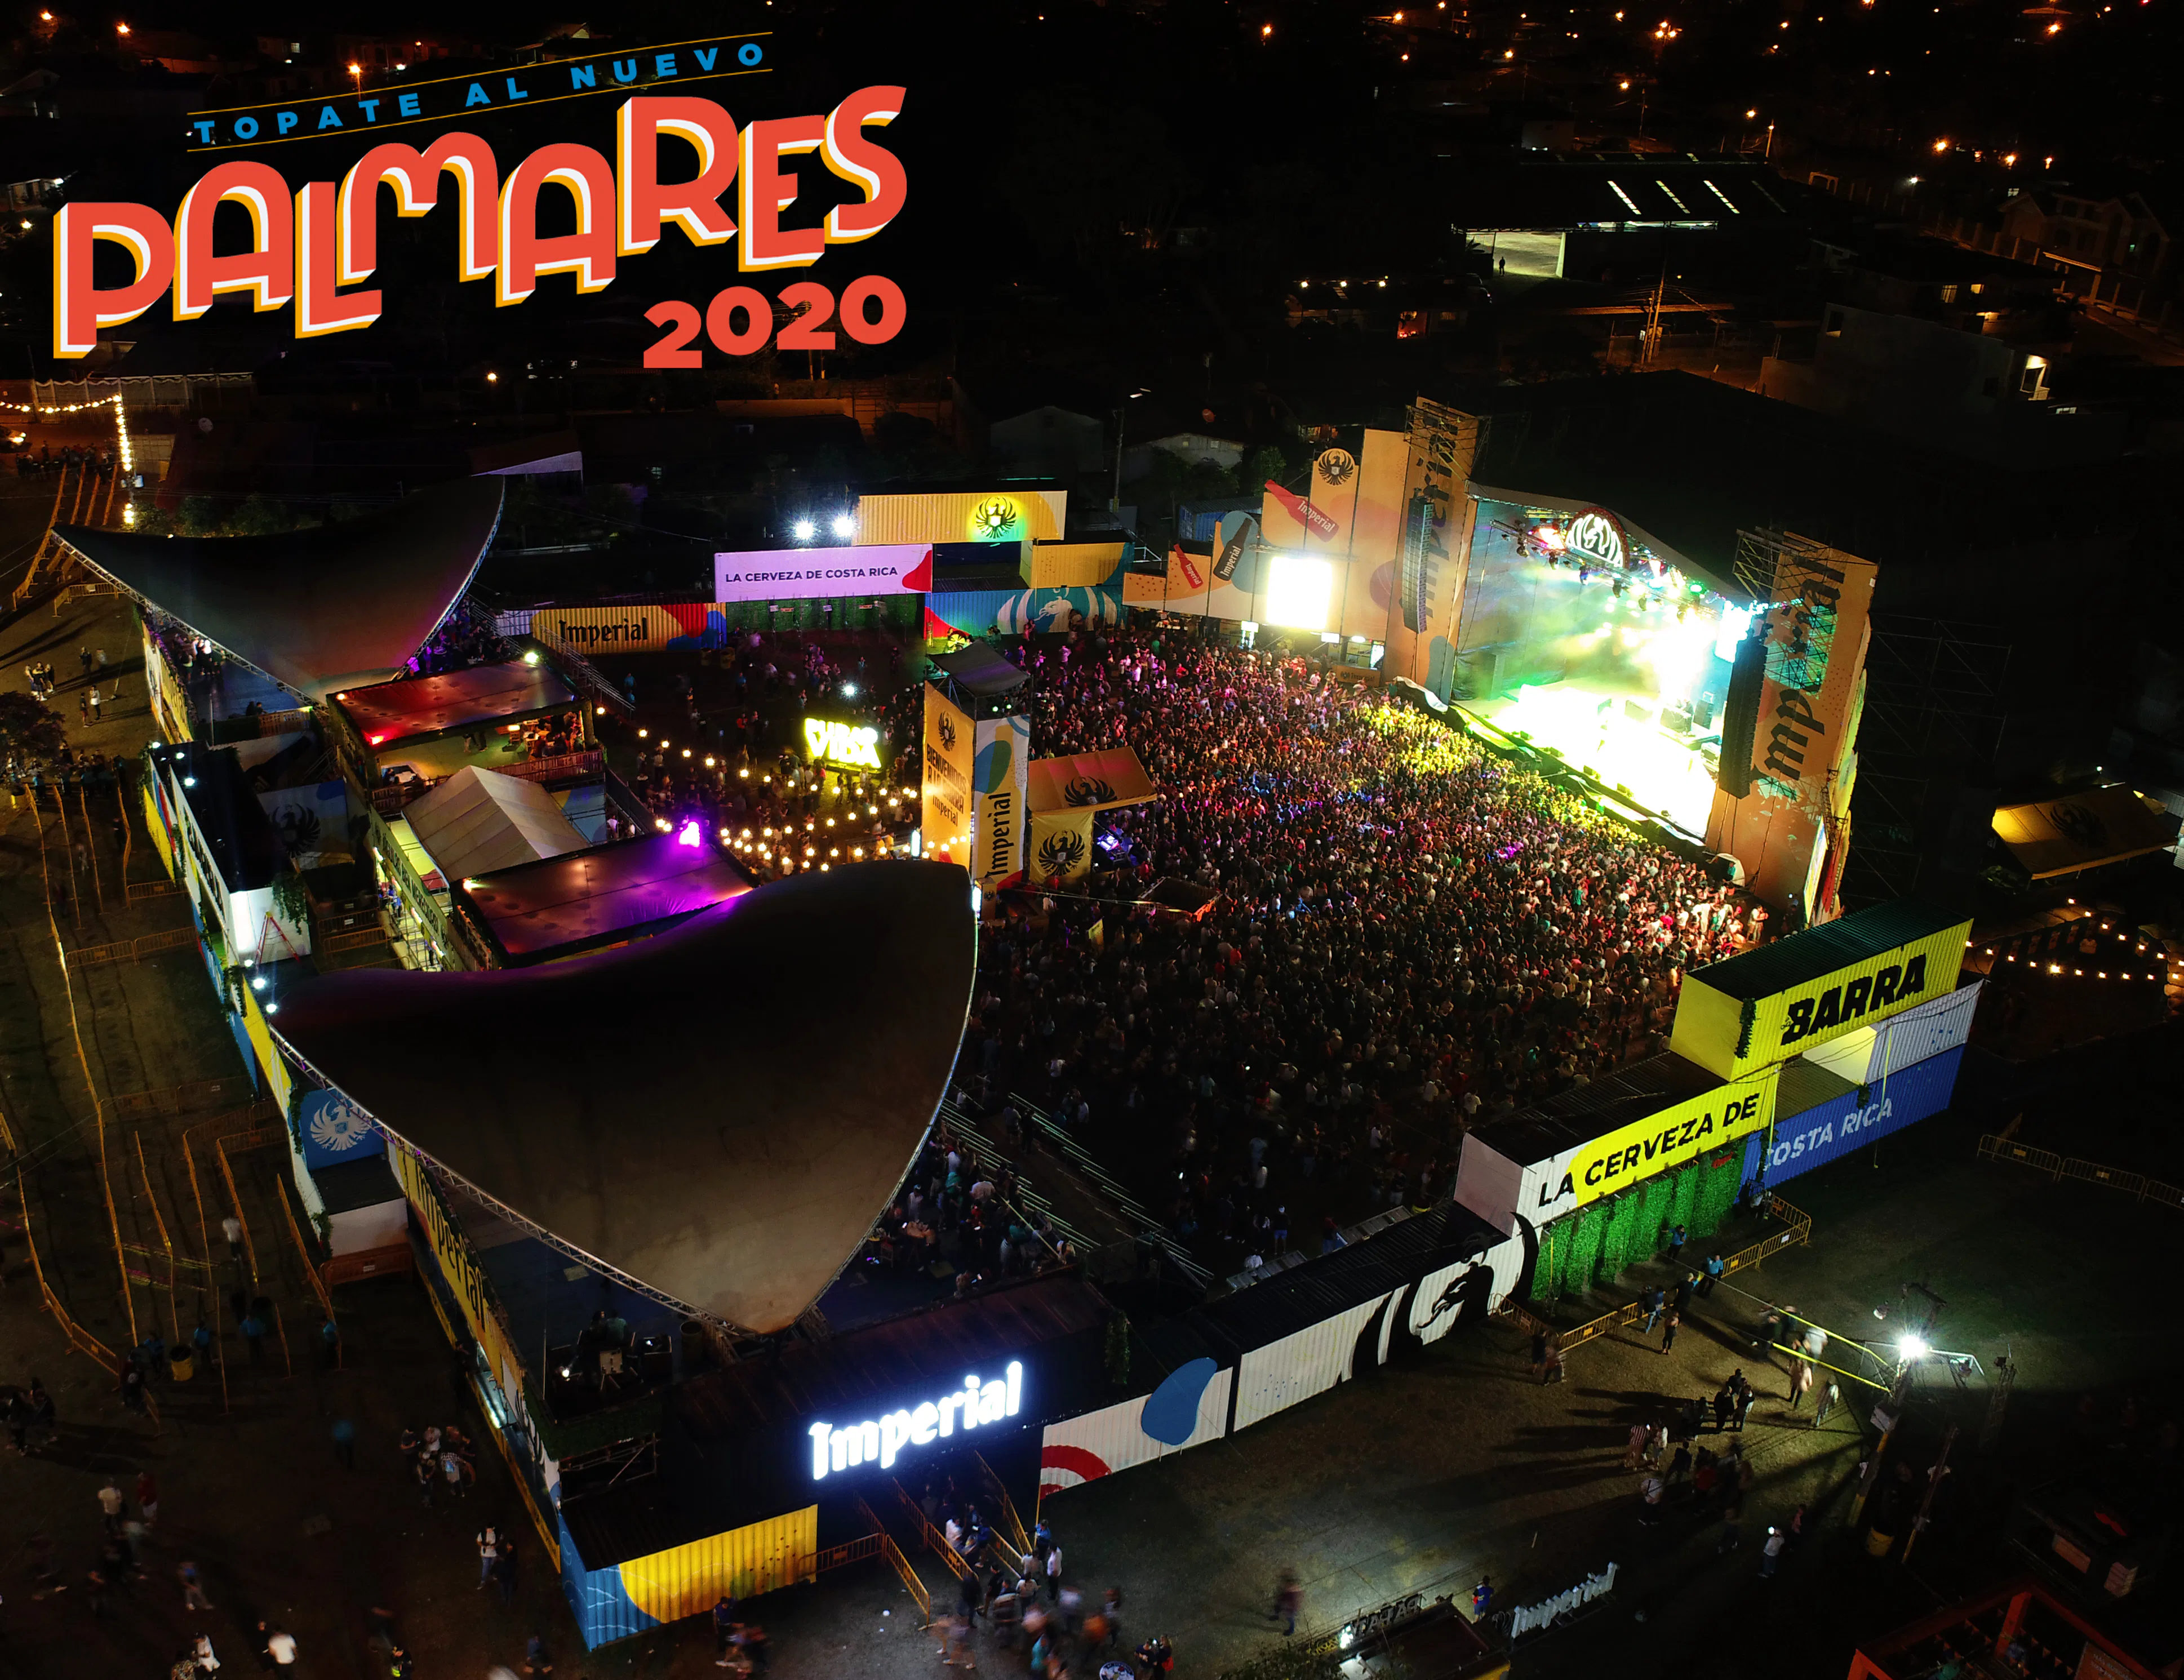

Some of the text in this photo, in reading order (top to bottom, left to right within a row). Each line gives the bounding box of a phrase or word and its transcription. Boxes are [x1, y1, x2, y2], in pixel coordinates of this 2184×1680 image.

[1297, 500, 1337, 533] Imperial
[725, 566, 898, 583] LA CERVEZA DE COSTA RICA
[1185, 563, 1201, 585] Imperial
[1219, 545, 1241, 577] Imperial
[558, 617, 648, 648] Imperial
[926, 743, 967, 795] BIENVENIDOS
[927, 765, 933, 784] A
[933, 794, 958, 827] Imperial
[984, 792, 1015, 878] Imperial
[1780, 953, 1926, 1046] BARRA
[1840, 1097, 1893, 1138] RICA
[1538, 1092, 1760, 1208] LA CERVEZA DE
[808, 1361, 1023, 1481] Imperial
